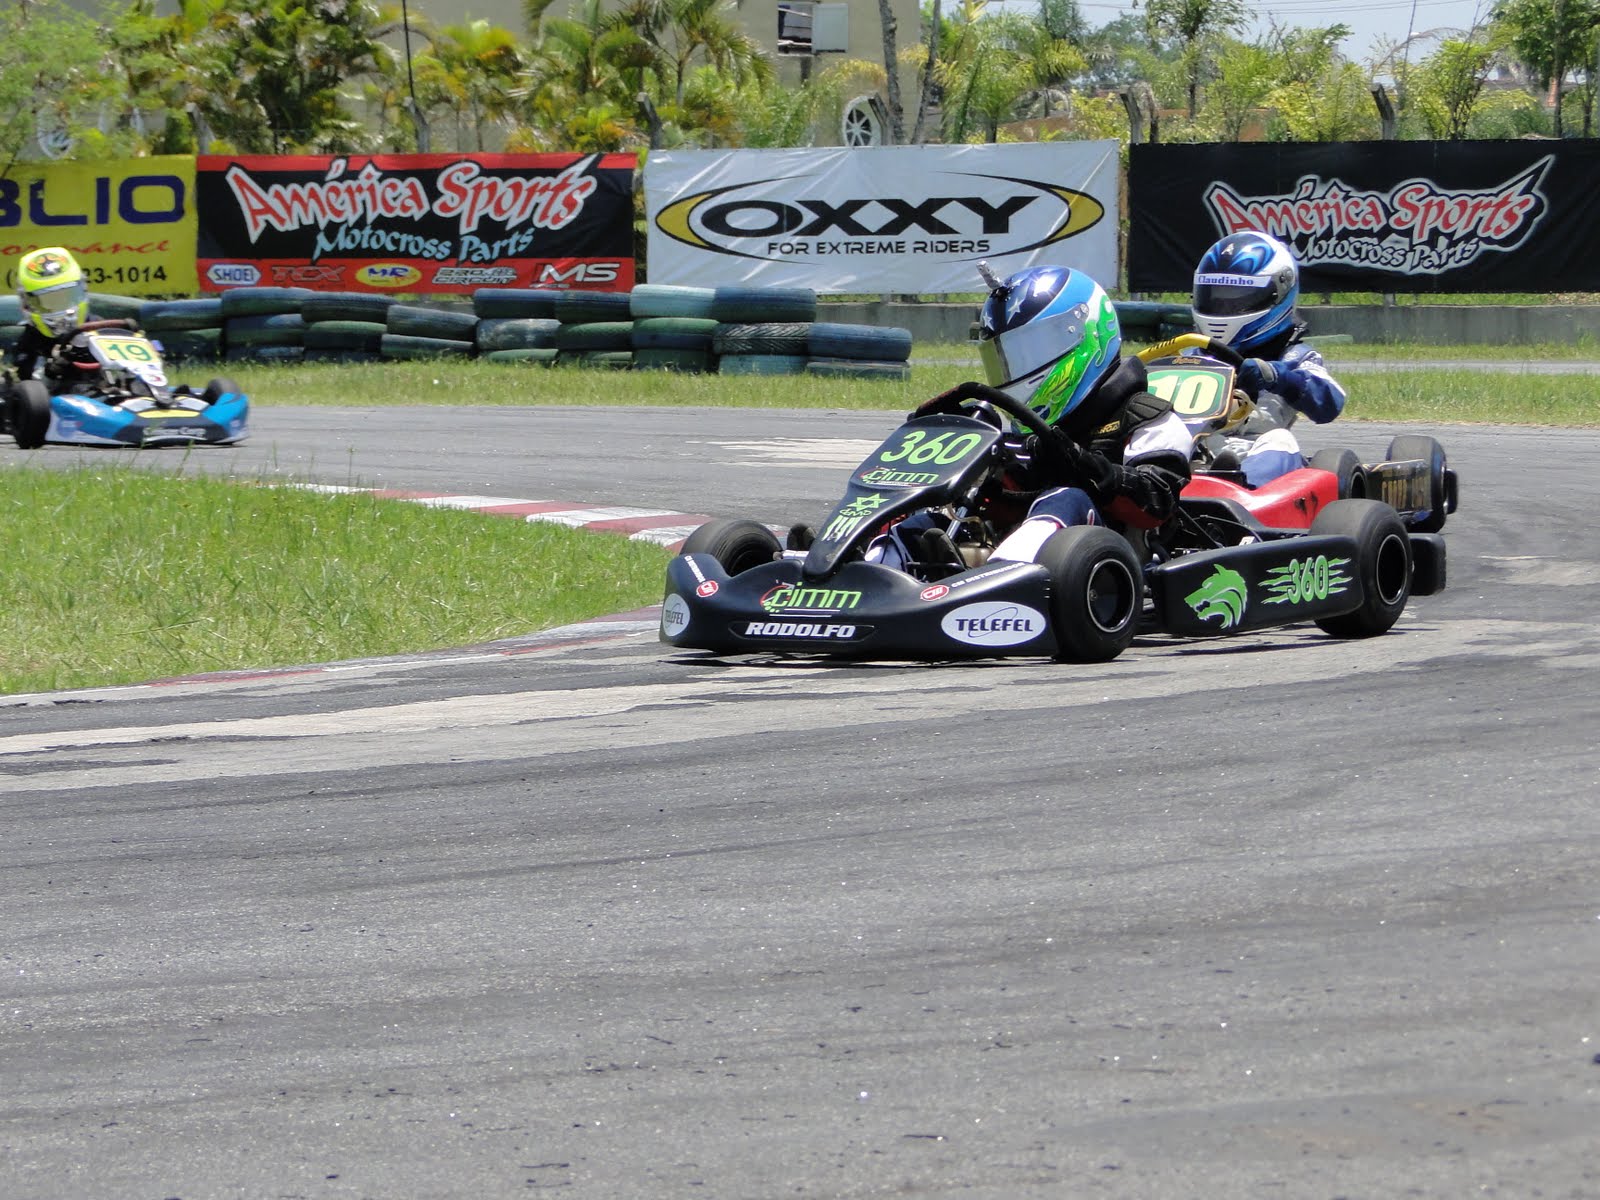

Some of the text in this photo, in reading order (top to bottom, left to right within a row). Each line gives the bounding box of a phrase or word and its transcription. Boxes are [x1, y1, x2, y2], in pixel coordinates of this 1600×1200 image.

[225, 154, 599, 245] América Sports
[700, 195, 1040, 238] OXXY
[1387, 172, 1537, 244] Sports
[312, 223, 536, 262] Motocross Parts
[767, 239, 991, 256] FOR EXTREME RIDERS
[1405, 236, 1480, 272] Parts
[213, 268, 255, 281] SHOEI
[539, 263, 621, 283] MS
[1198, 275, 1254, 285] Claudinho
[107, 344, 152, 361] 19
[1148, 374, 1219, 415] 10
[880, 430, 982, 465] 360
[1286, 554, 1329, 605] 360
[745, 621, 856, 638] RODOLFO
[955, 618, 1034, 632] TELEFEL
